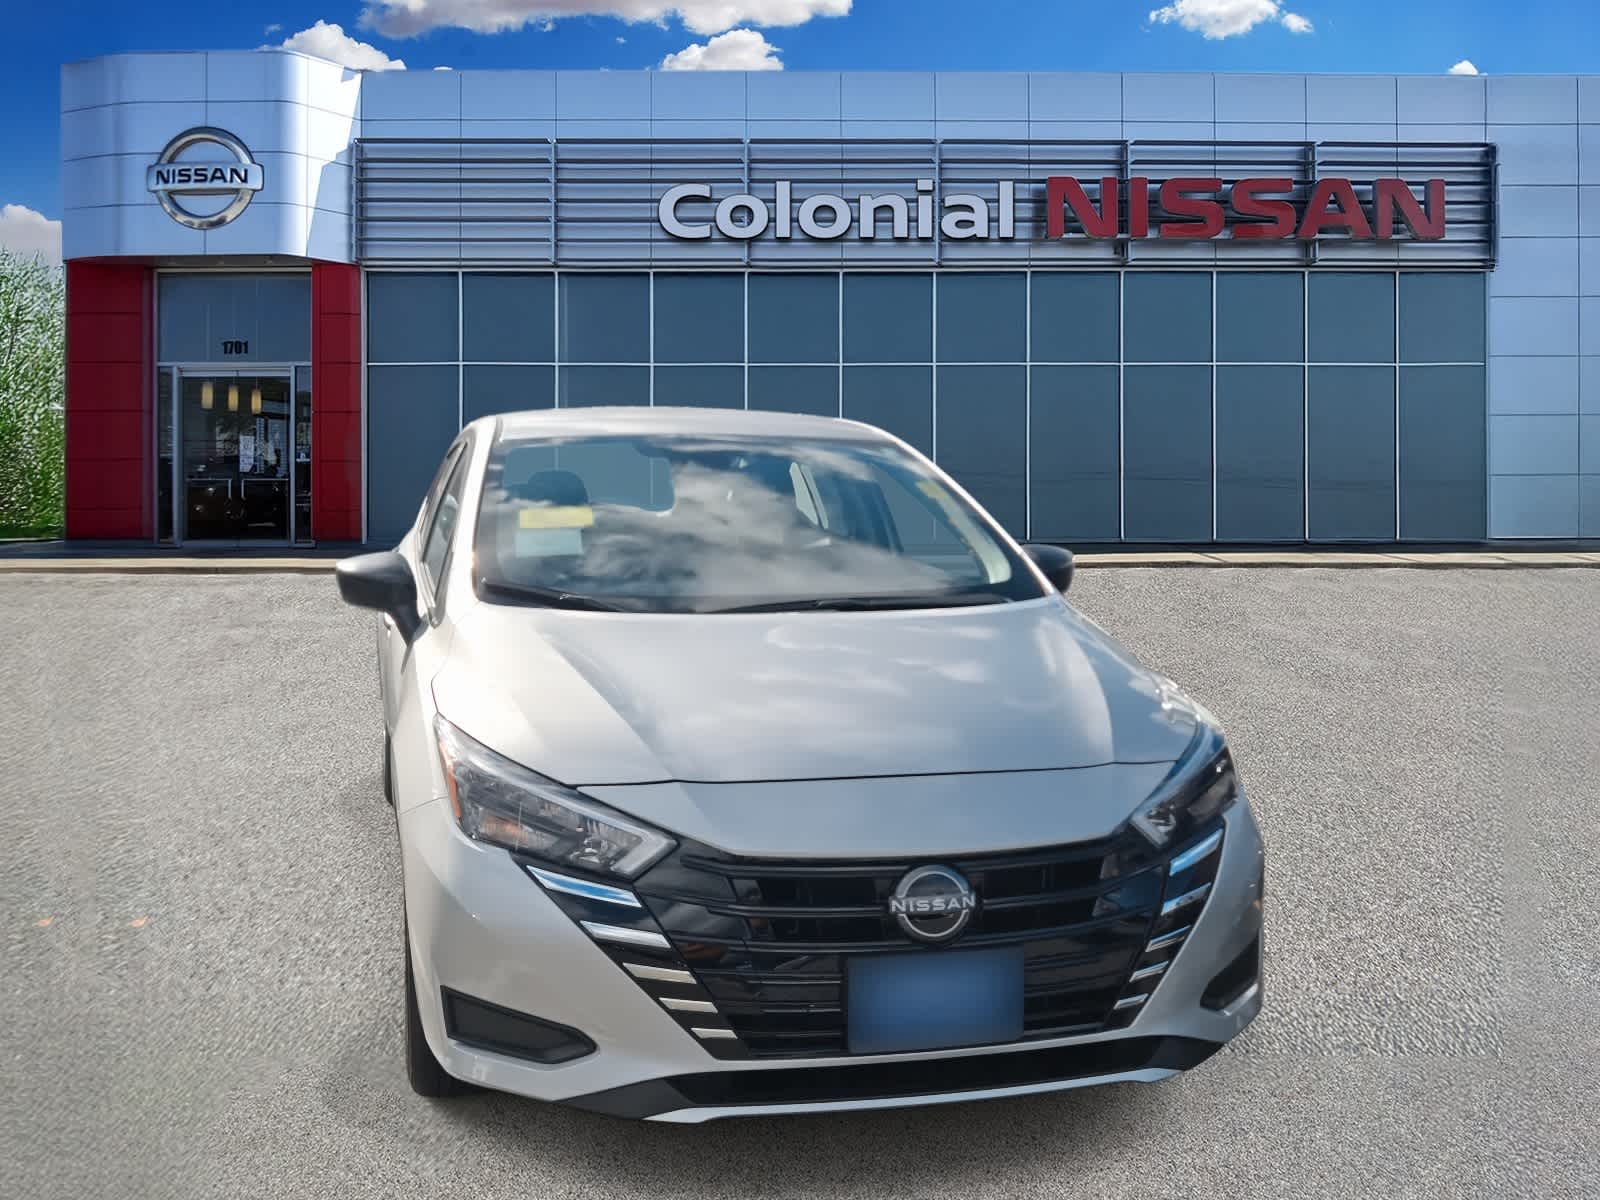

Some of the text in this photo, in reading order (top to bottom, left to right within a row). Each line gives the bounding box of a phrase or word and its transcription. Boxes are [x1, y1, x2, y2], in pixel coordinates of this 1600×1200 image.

[156, 167, 248, 184] NISSAN
[657, 176, 1447, 241] Colonial NISSAN
[222, 340, 249, 355] 1701
[890, 893, 976, 913] NISSAN
